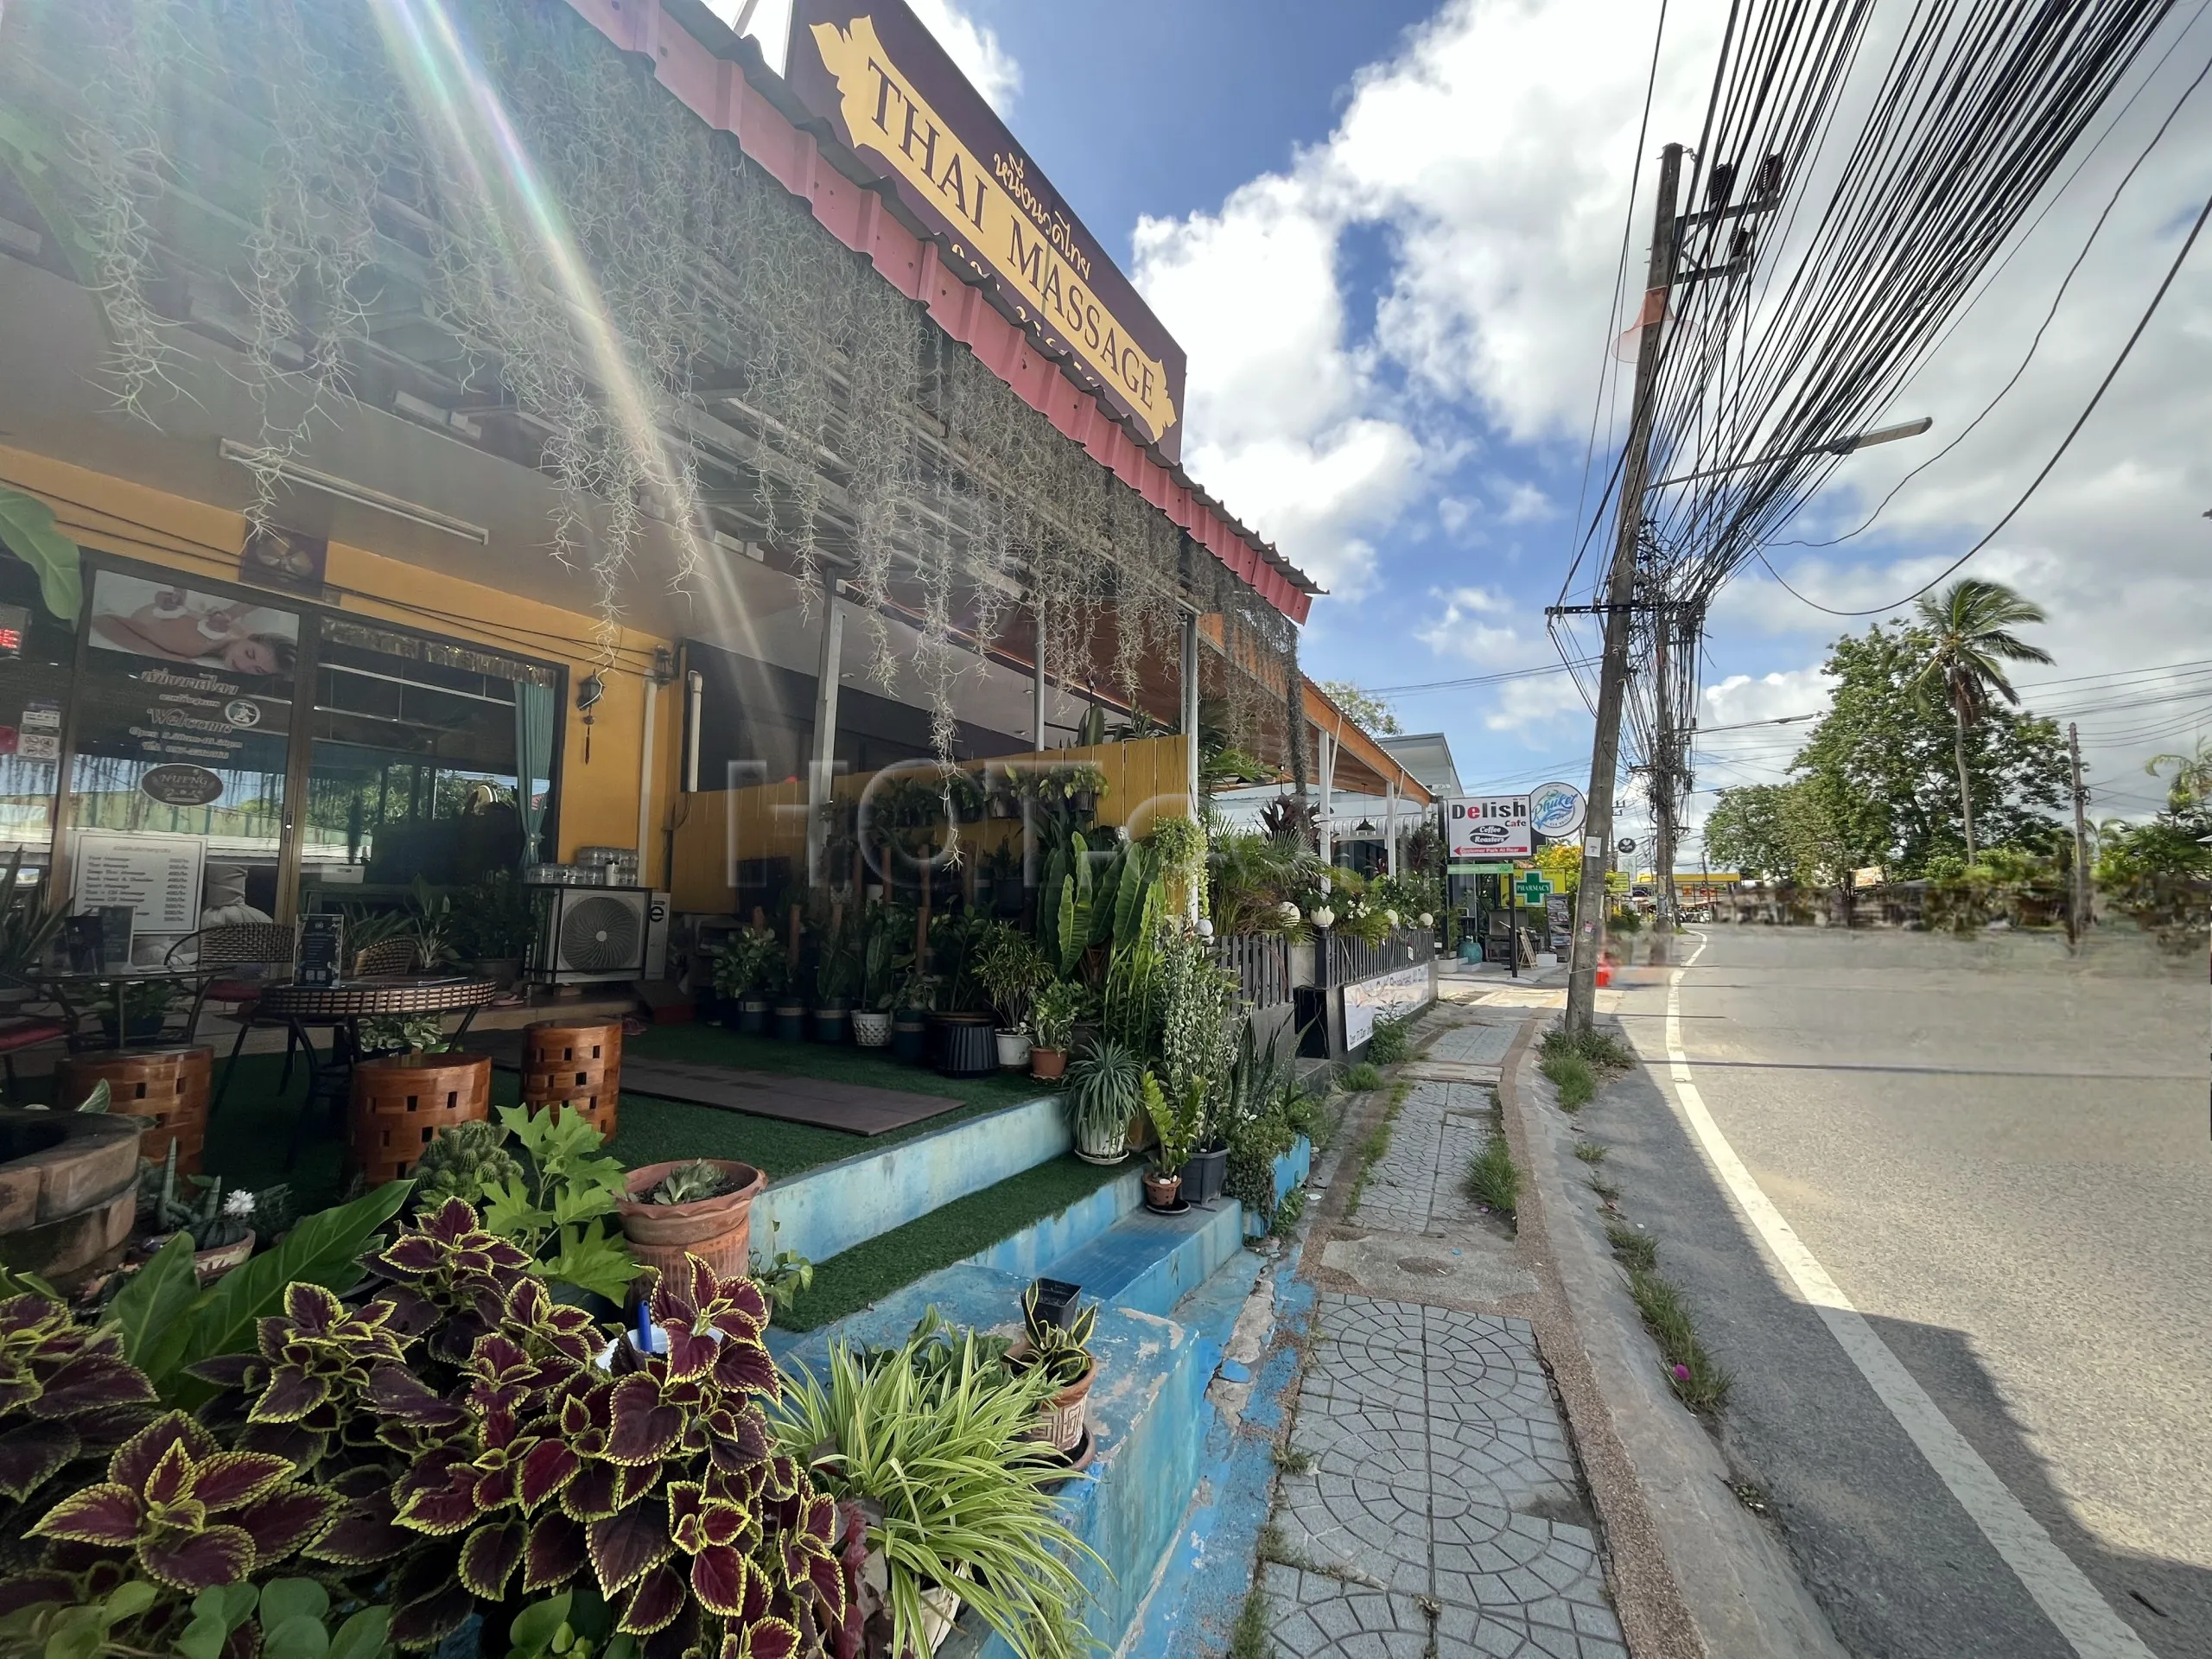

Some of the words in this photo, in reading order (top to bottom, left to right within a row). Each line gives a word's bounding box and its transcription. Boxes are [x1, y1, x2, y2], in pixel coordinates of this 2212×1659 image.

[994, 152, 1091, 281] หนึ่งนวดไทย
[868, 56, 988, 233] THAI
[1007, 214, 1154, 410] MASSAGE
[146, 708, 234, 734] Welcome
[1452, 801, 1527, 820] Delish
[1531, 793, 1579, 823] Phuket
[1479, 826, 1502, 835] Coffee
[1504, 819, 1527, 828] Cafe
